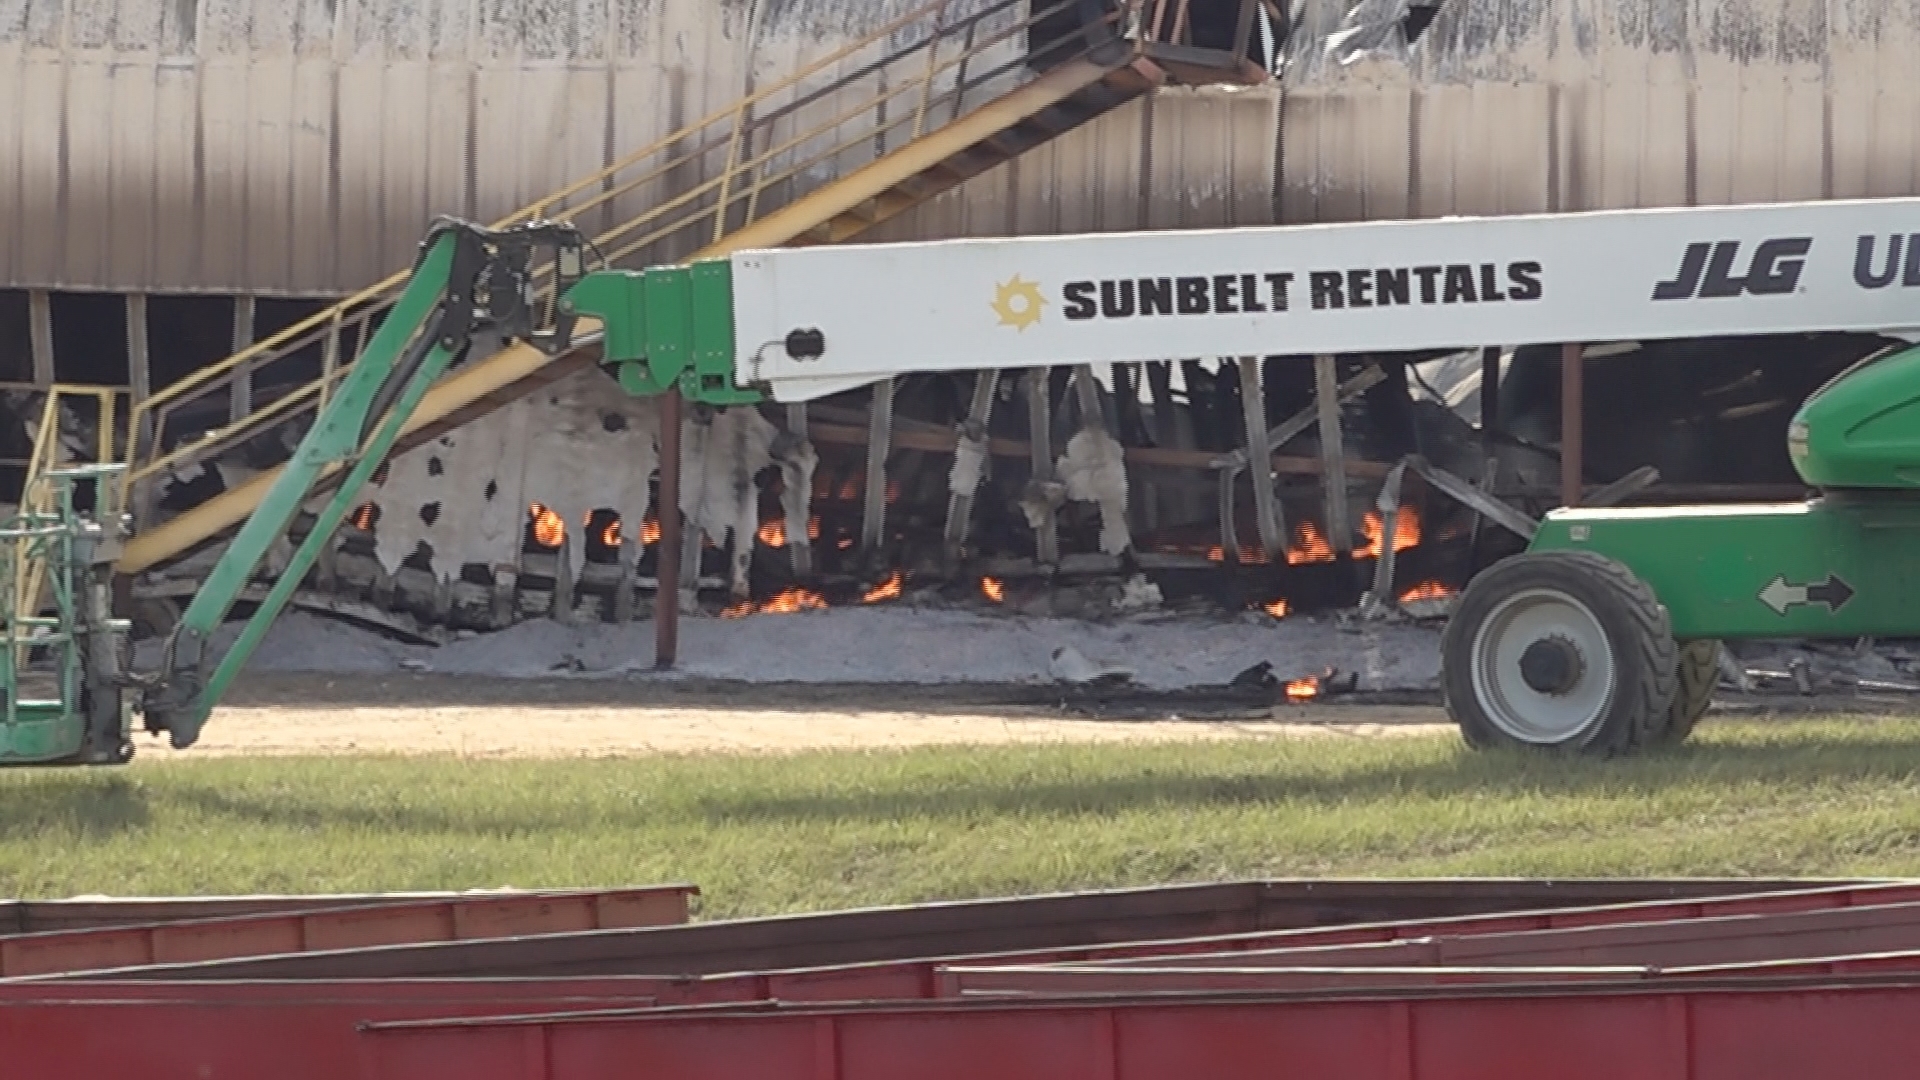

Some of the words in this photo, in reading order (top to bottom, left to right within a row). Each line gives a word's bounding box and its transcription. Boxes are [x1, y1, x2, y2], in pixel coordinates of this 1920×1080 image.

[1063, 272, 1294, 319] SUNBELT
[1308, 261, 1543, 309] RENTALS
[1651, 237, 1813, 300] JLG
